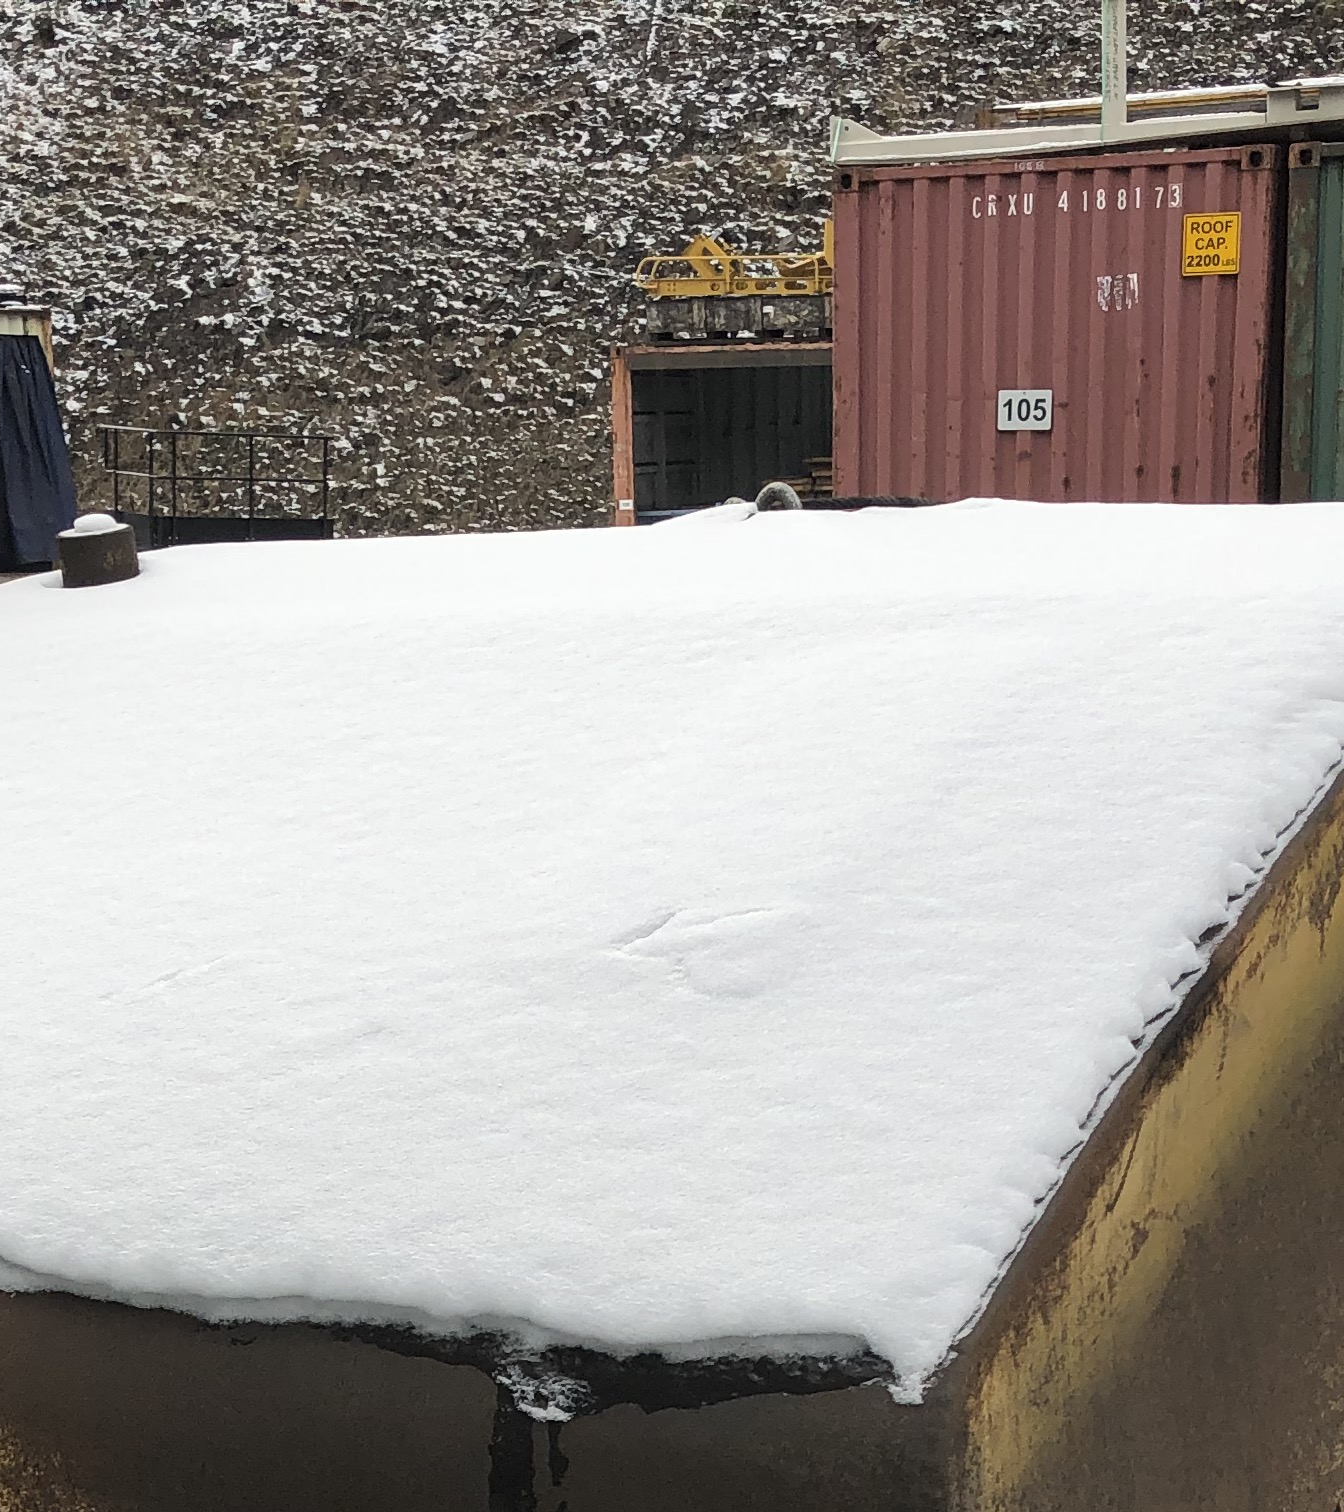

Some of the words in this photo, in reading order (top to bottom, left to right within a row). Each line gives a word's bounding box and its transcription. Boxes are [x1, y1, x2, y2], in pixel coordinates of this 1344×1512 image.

[972, 193, 1034, 219] CRXU
[1190, 220, 1234, 234] ROOF
[1194, 236, 1228, 250] CAP.
[1186, 254, 1220, 268] 2200
[1002, 398, 1047, 422] 105
